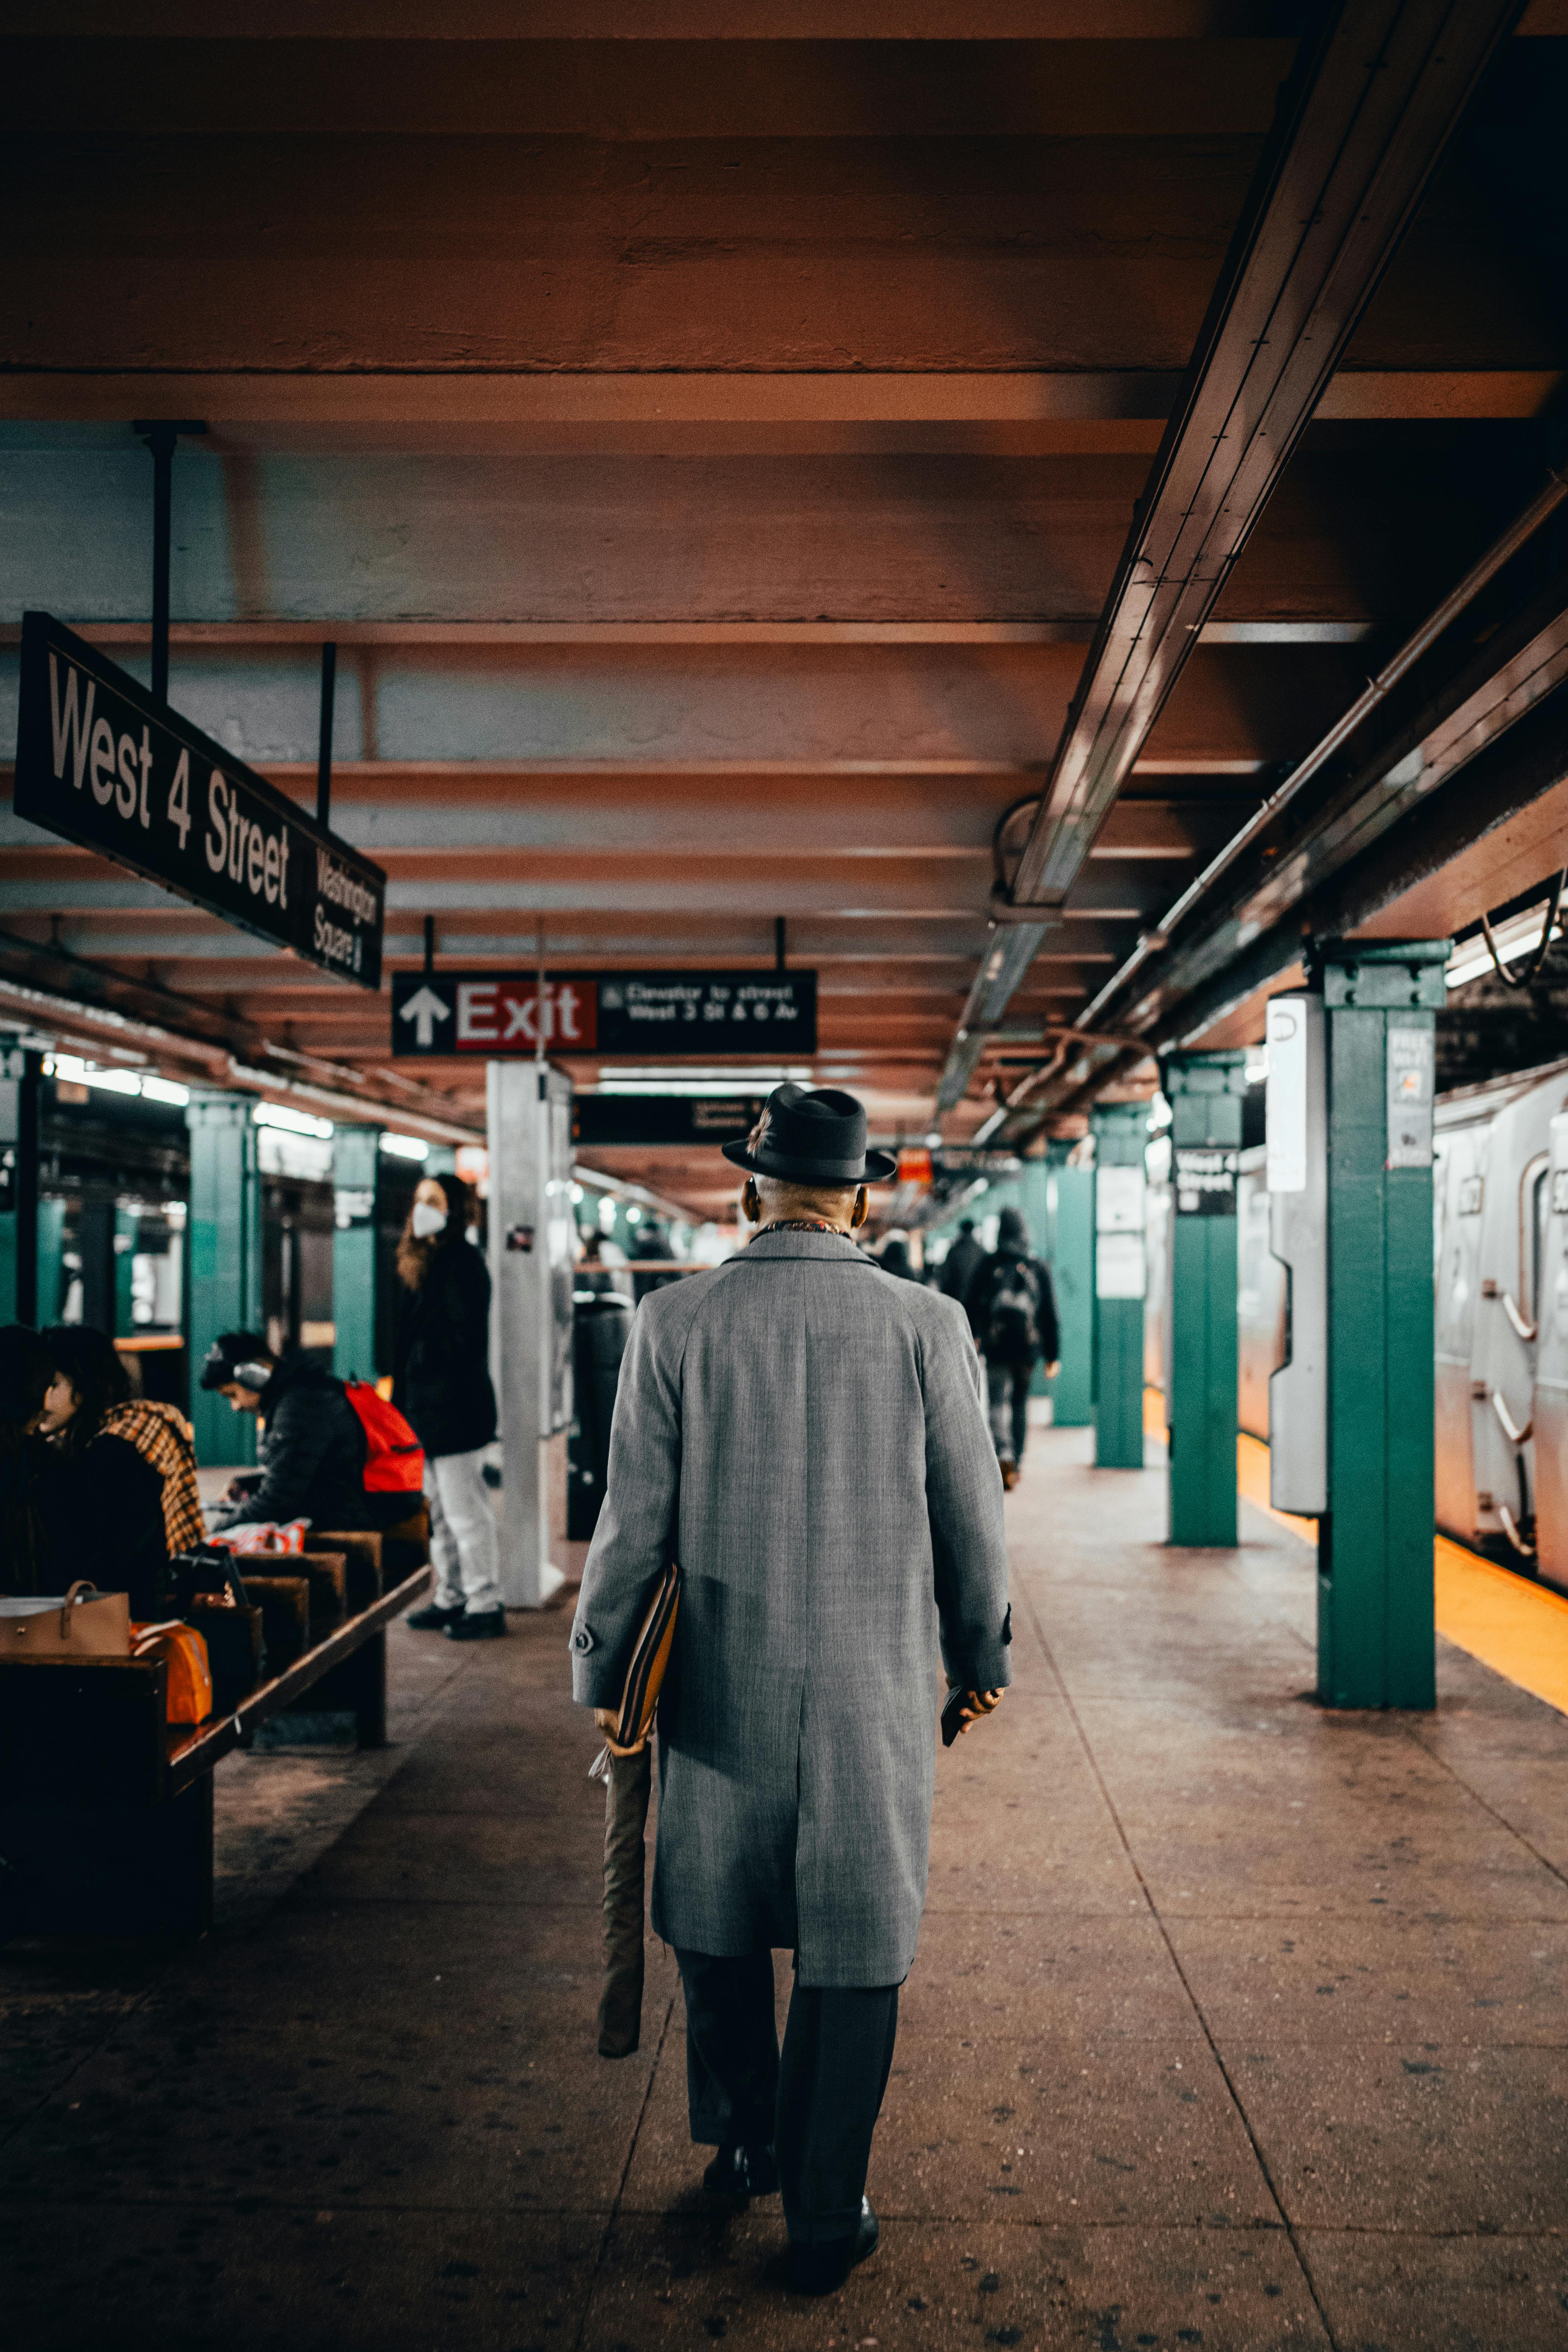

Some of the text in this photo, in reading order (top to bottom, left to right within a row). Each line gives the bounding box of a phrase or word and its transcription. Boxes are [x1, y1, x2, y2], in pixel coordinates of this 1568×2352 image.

[48, 652, 289, 910] West 4 Street
[317, 846, 376, 925] Washington
[314, 903, 353, 967] Square
[456, 984, 581, 1040] Exit
[629, 1003, 675, 1022] West
[710, 984, 731, 1001] to
